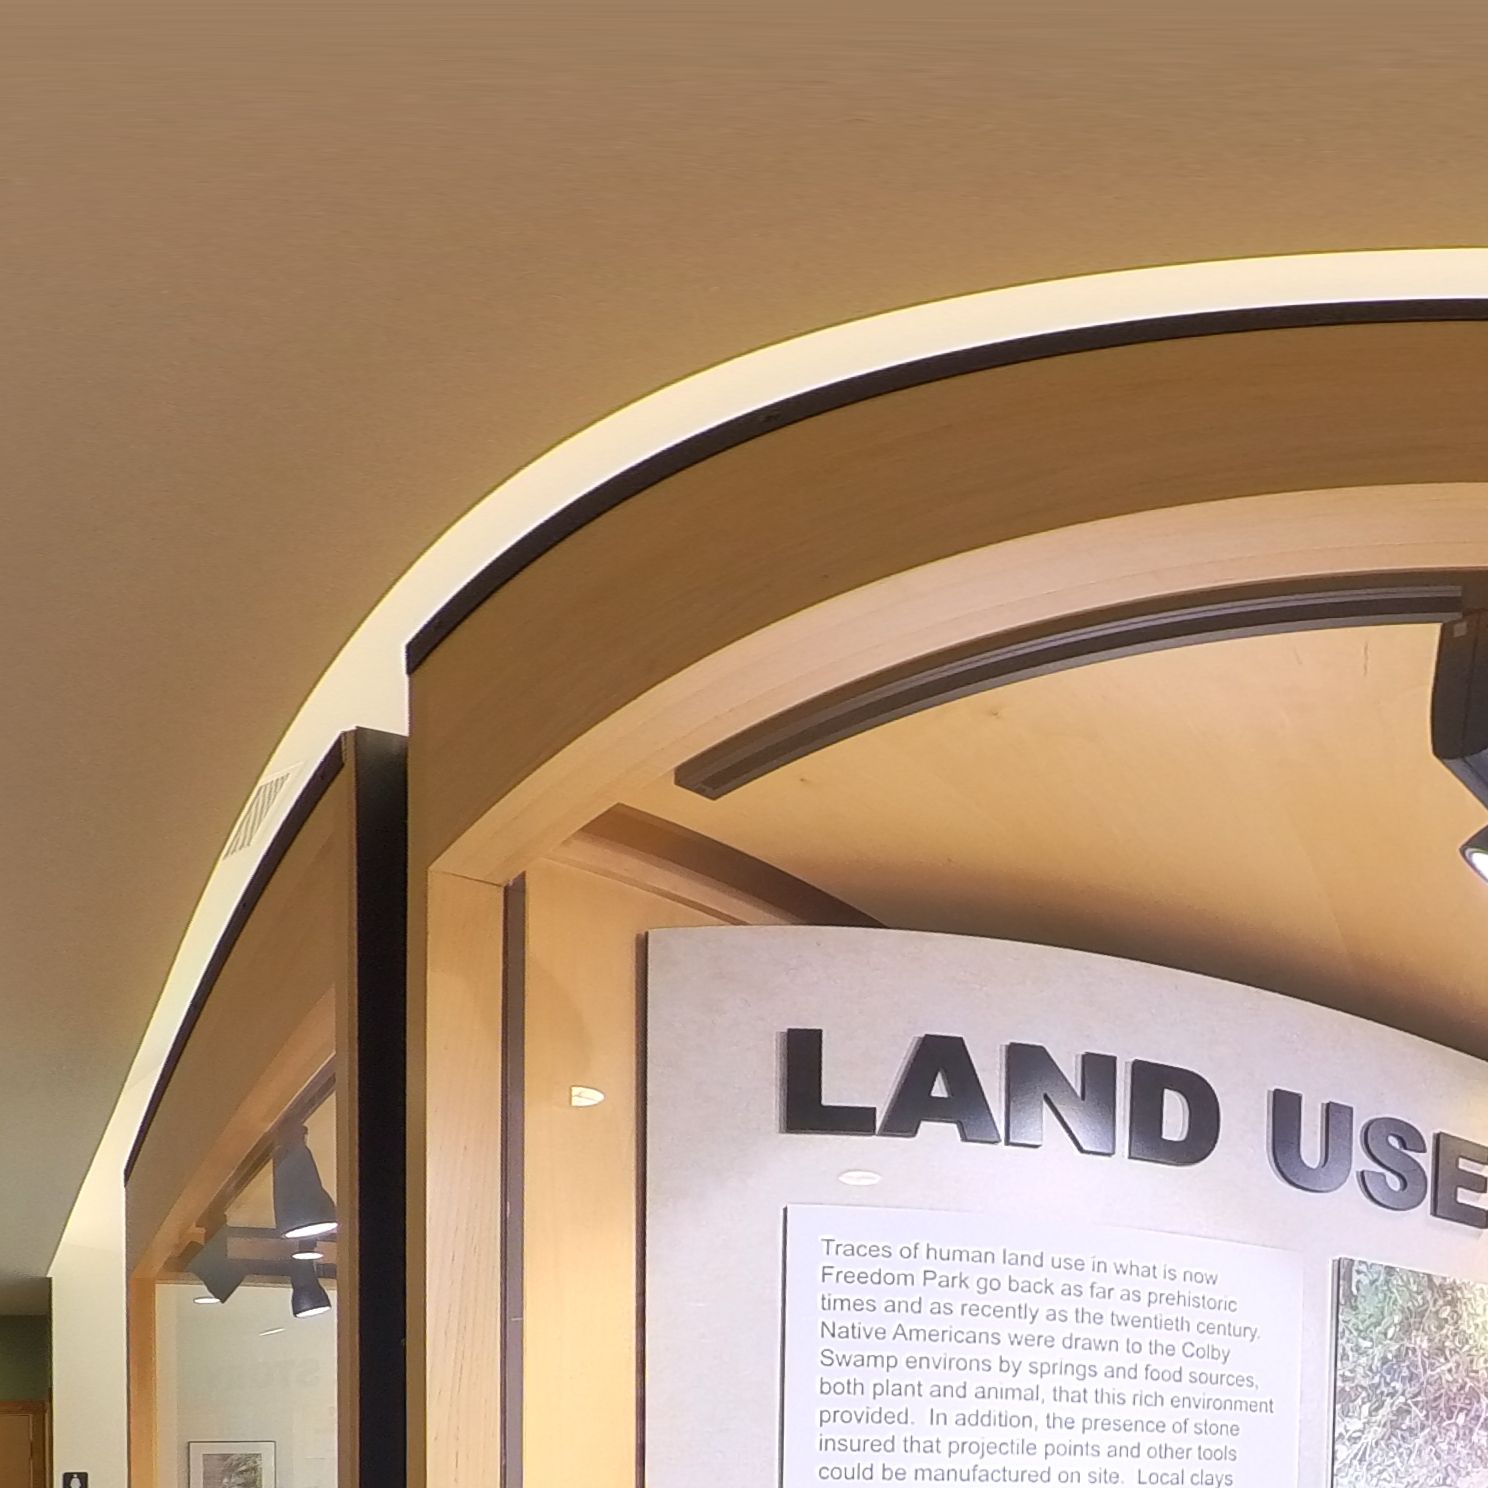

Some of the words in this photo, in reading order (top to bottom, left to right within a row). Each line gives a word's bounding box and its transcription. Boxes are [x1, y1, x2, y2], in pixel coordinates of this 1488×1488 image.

[782, 1028, 1220, 1166] LAND
[1267, 1088, 1488, 1229] USE
[820, 1238, 893, 1259] Traces
[899, 1242, 920, 1260] of
[926, 1242, 995, 1264] human
[1002, 1248, 1044, 1268] land
[1051, 1256, 1086, 1272] use
[1090, 1256, 1108, 1274] in
[1113, 1260, 1158, 1280] what
[1162, 1264, 1177, 1282] is
[1183, 1270, 1218, 1286] now
[821, 1265, 915, 1287] Freedom
[922, 1269, 970, 1290] Park
[976, 1276, 1002, 1295] go
[1008, 1274, 1055, 1296] back
[1060, 1283, 1084, 1298] as
[1089, 1281, 1115, 1300] far
[1120, 1288, 1142, 1303] as
[1147, 1290, 1238, 1313] prehistoric
[821, 1292, 877, 1313] times
[884, 1296, 922, 1314] and
[929, 1301, 954, 1316] as
[960, 1302, 1040, 1325] recently
[1045, 1308, 1068, 1323] as
[1074, 1306, 1104, 1326] the
[1110, 1310, 1190, 1333] twentieth
[1196, 1321, 1260, 1343] century.
[820, 1320, 887, 1341] Native
[892, 1322, 1002, 1346] Americans
[1008, 1332, 1056, 1348] were
[1062, 1332, 1119, 1352] drawn
[1126, 1337, 1142, 1354] to
[1148, 1338, 1176, 1357] the
[1182, 1341, 1231, 1366] Colby
[820, 1348, 898, 1373] Swamp
[905, 1352, 992, 1372] environs
[998, 1354, 1022, 1378] by
[1028, 1360, 1098, 1382] springs
[1104, 1362, 1138, 1380] and
[1144, 1363, 1183, 1383] food
[1188, 1370, 1259, 1390] sources,
[819, 1406, 915, 1428] provided.
[930, 1407, 948, 1426] In
[954, 1408, 1038, 1432] addition,
[1046, 1412, 1076, 1430] the
[1082, 1417, 1166, 1435] presence
[1172, 1417, 1190, 1434] of
[1194, 1418, 1240, 1437] stone
[819, 1432, 896, 1454] insured
[902, 1434, 942, 1454] that
[948, 1438, 1037, 1460] projectile
[1044, 1439, 1100, 1461] points
[1107, 1441, 1141, 1459] and
[1146, 1442, 1193, 1460] other
[1197, 1444, 1237, 1462] tools
